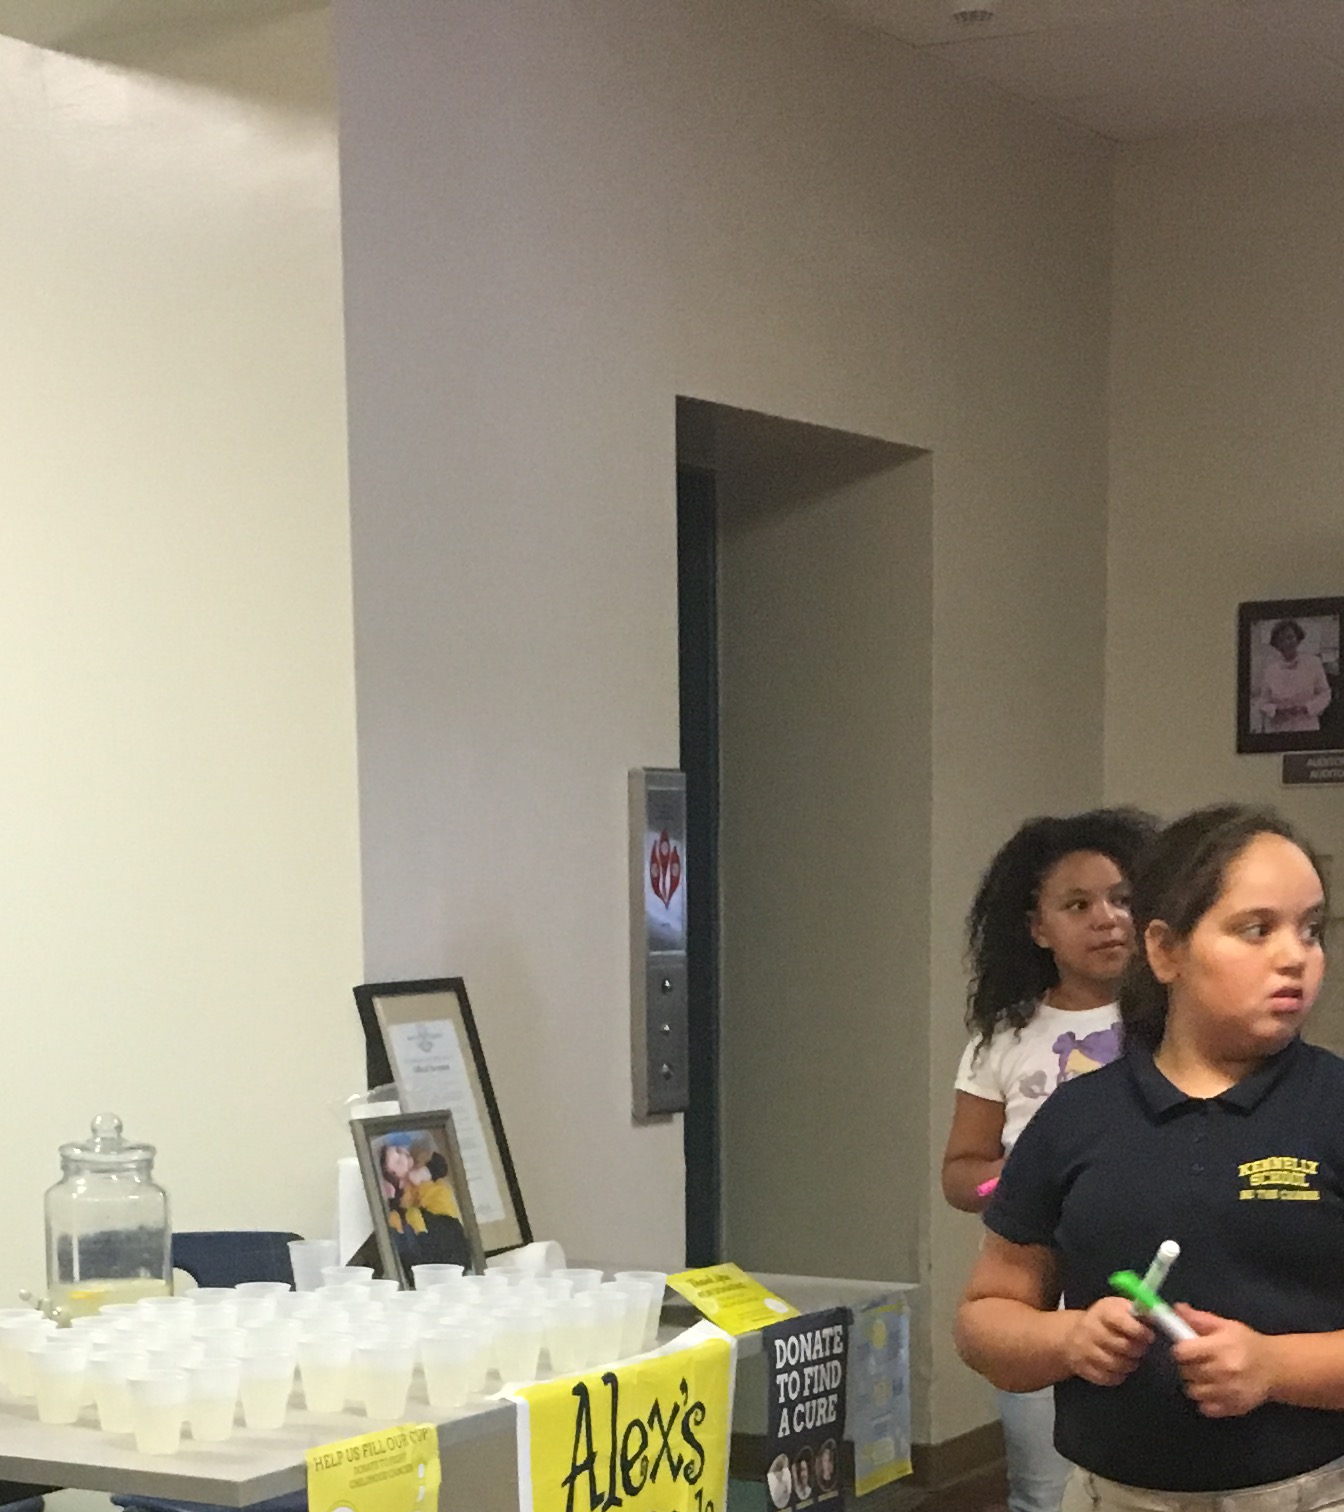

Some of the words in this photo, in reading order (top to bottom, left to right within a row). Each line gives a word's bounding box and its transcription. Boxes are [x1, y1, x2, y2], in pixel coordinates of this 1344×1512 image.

[774, 1325, 844, 1370] DONATE
[776, 1371, 801, 1403] TO
[803, 1360, 842, 1397] FIND
[777, 1407, 790, 1438] A
[793, 1394, 838, 1433] CURE
[313, 1451, 345, 1472] HELP
[347, 1446, 361, 1462] US
[362, 1439, 387, 1458] FILL
[387, 1433, 409, 1453] OUR
